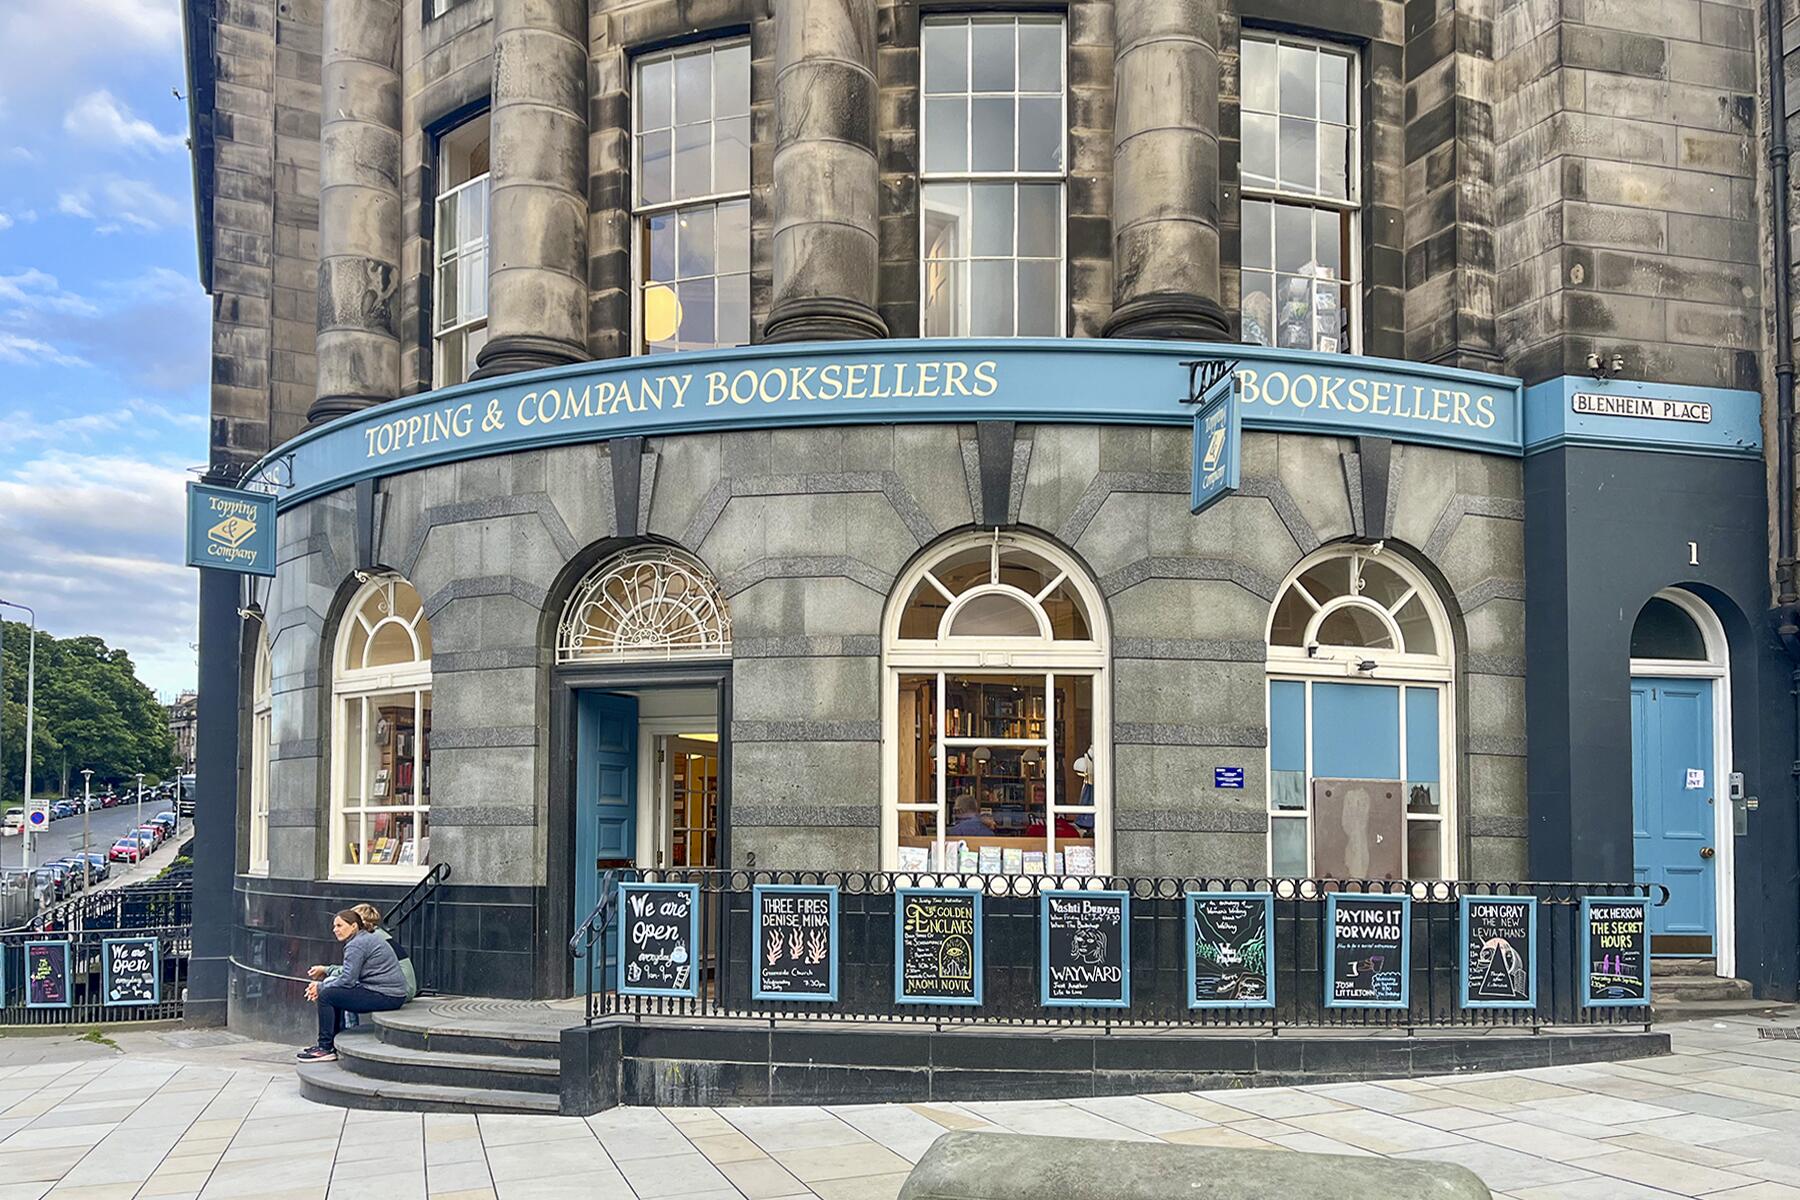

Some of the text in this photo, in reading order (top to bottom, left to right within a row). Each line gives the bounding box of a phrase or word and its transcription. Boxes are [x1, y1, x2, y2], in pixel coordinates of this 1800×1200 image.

[1235, 369, 1497, 429] BOOKSELLERS
[363, 361, 998, 458] TOPPING & COMPANY BOOKSELLERS
[1577, 395, 1709, 420] BLENHEIM PLACE
[208, 496, 258, 521] Topping
[221, 520, 238, 538] &
[207, 543, 258, 566] Company
[1687, 541, 1699, 565] 1
[746, 851, 756, 867] 2
[630, 892, 688, 918] We are
[763, 898, 829, 914] THREE FIRES
[937, 906, 973, 920] GOLDEN
[1050, 899, 1120, 917] Vashti Bunyan
[1471, 906, 1524, 918] JOHN GRAY
[762, 914, 830, 928] DENISE MINA
[908, 906, 974, 935] ENCLAVES
[1336, 908, 1401, 925] PAYING IT
[1590, 908, 1642, 920] MICK HERRON
[1482, 918, 1520, 927] THE NEW
[1590, 922, 1644, 935] THE SECRET
[633, 920, 679, 950] Open
[1336, 925, 1401, 940] FORWARD
[1472, 928, 1526, 938] LEVIATHANS
[1600, 935, 1633, 948] HOURS
[112, 944, 146, 959] We are
[638, 948, 673, 968] everyday
[791, 967, 814, 977] Church
[1050, 966, 1122, 982] WAYWARD
[906, 980, 972, 993] NAOMI NOVIK
